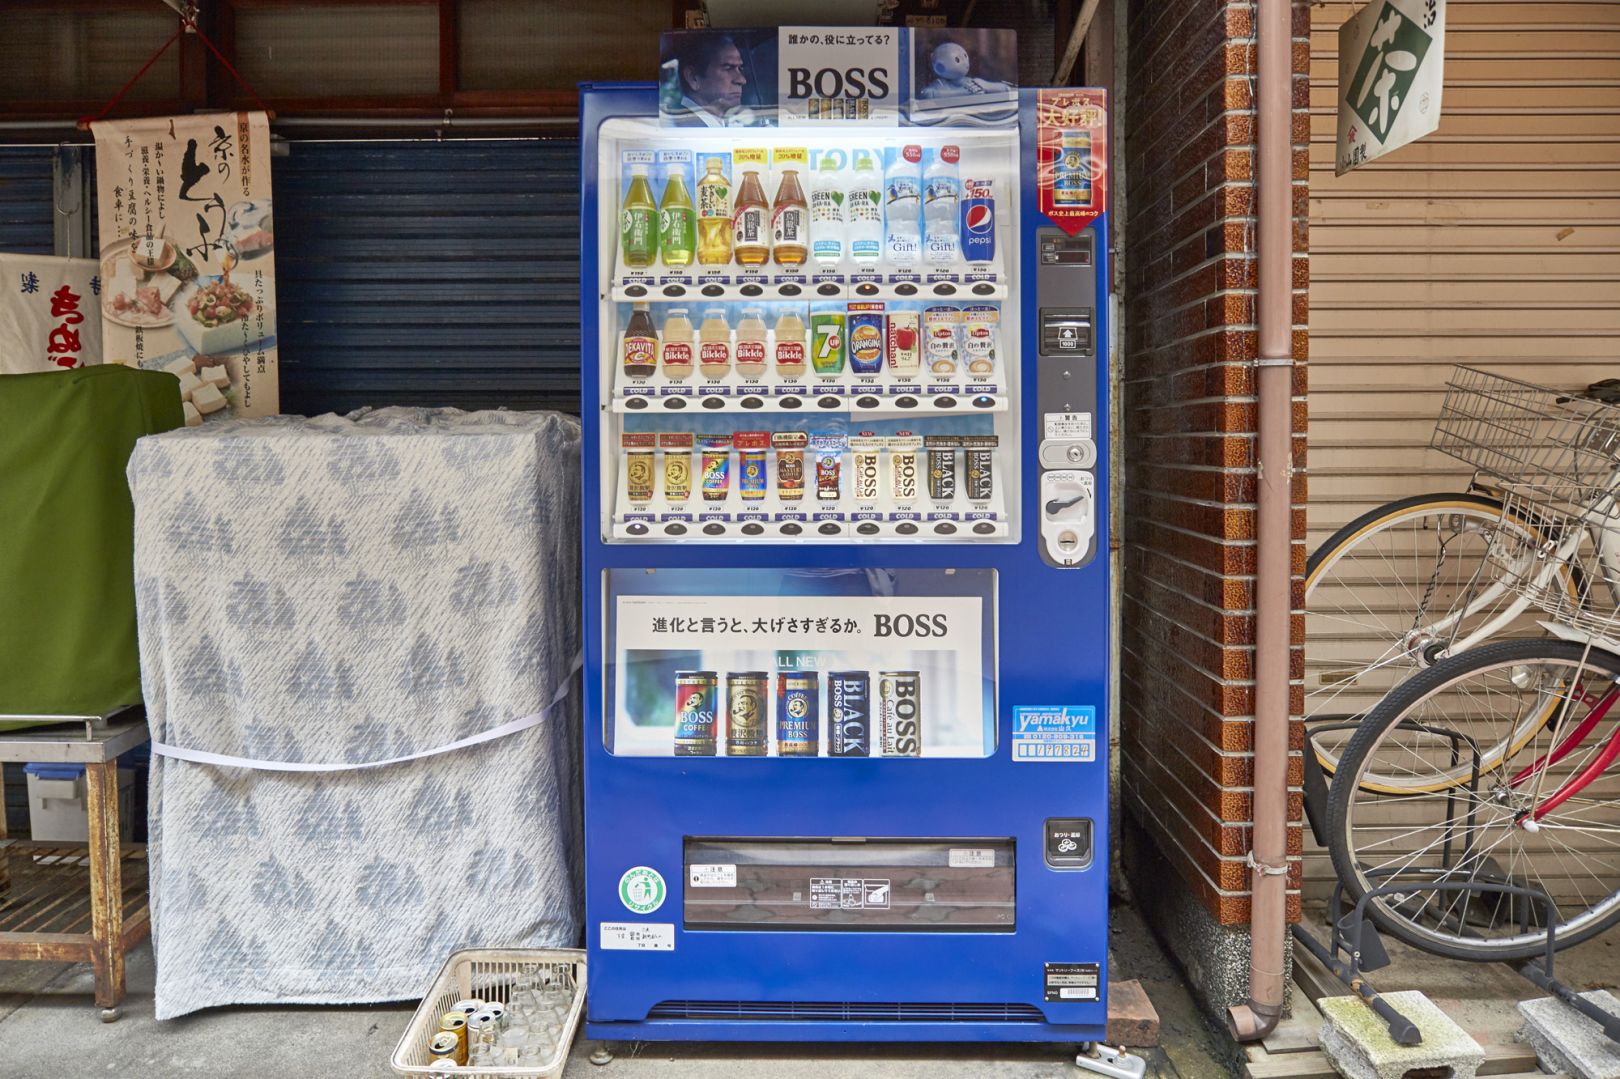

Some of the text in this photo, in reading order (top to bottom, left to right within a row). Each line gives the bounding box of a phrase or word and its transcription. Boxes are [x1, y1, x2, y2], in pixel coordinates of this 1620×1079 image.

[787, 67, 890, 100] BOSS
[968, 237, 992, 245] pepsi
[935, 330, 952, 338] Lipton
[971, 329, 989, 337] Lipton
[737, 349, 763, 358] Bikkle
[851, 338, 881, 353] ORANGINA
[890, 322, 899, 369] natchan!
[665, 351, 691, 360] Bikkle
[702, 351, 727, 360] Bikkle
[777, 351, 802, 360] Bikkle
[704, 471, 725, 479] BOSS
[865, 455, 877, 498] BOSS
[903, 455, 915, 497] BOSS
[942, 452, 954, 498] BLACK
[979, 452, 992, 497] BLACK
[652, 613, 948, 638] 進化と言うと、大げさすぎるか。 BOSS
[834, 680, 842, 708] BOSS
[681, 711, 713, 723] BOSS
[843, 679, 865, 753] BLACK
[895, 679, 916, 754] BOSS
[1019, 707, 1089, 732] yamakyu
[788, 730, 808, 738] BOSS
[887, 722, 893, 734] au
[886, 736, 895, 753] Lait
